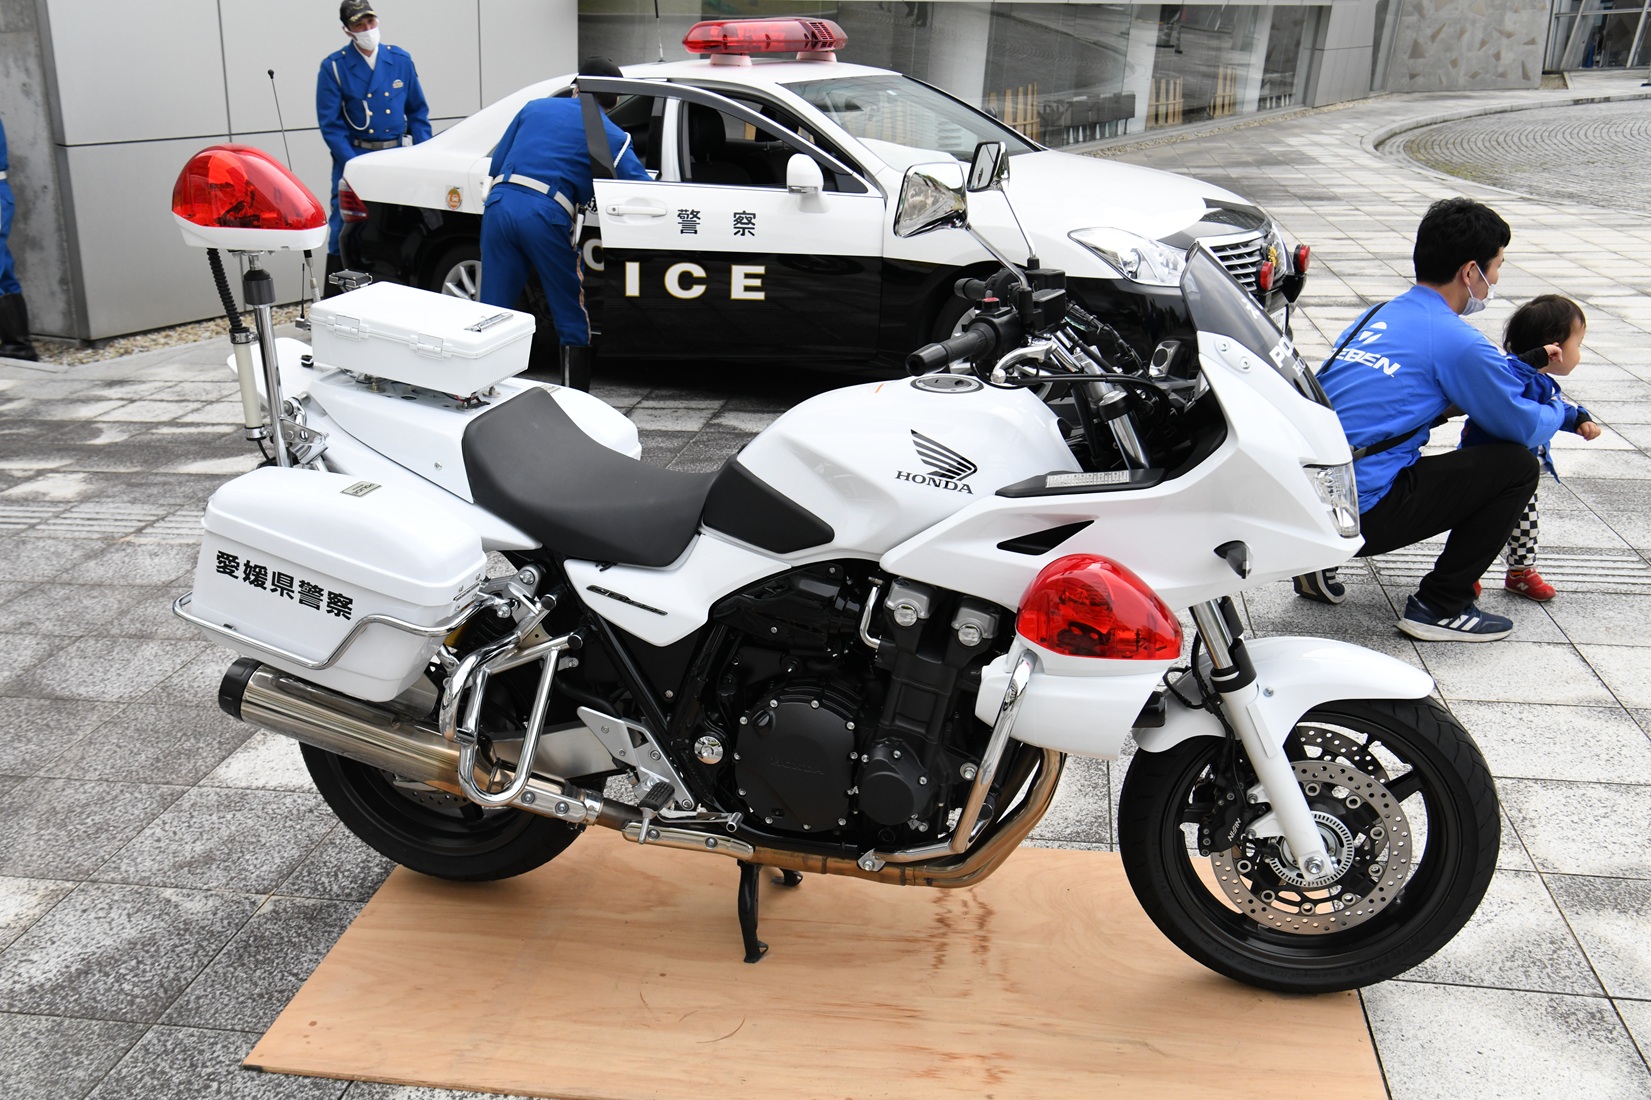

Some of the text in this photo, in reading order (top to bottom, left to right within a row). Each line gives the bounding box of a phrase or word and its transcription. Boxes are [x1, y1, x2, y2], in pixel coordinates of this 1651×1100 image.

[677, 209, 756, 236] 警察
[895, 470, 974, 495] HONDA
[216, 550, 354, 620] 愛媛県警察
